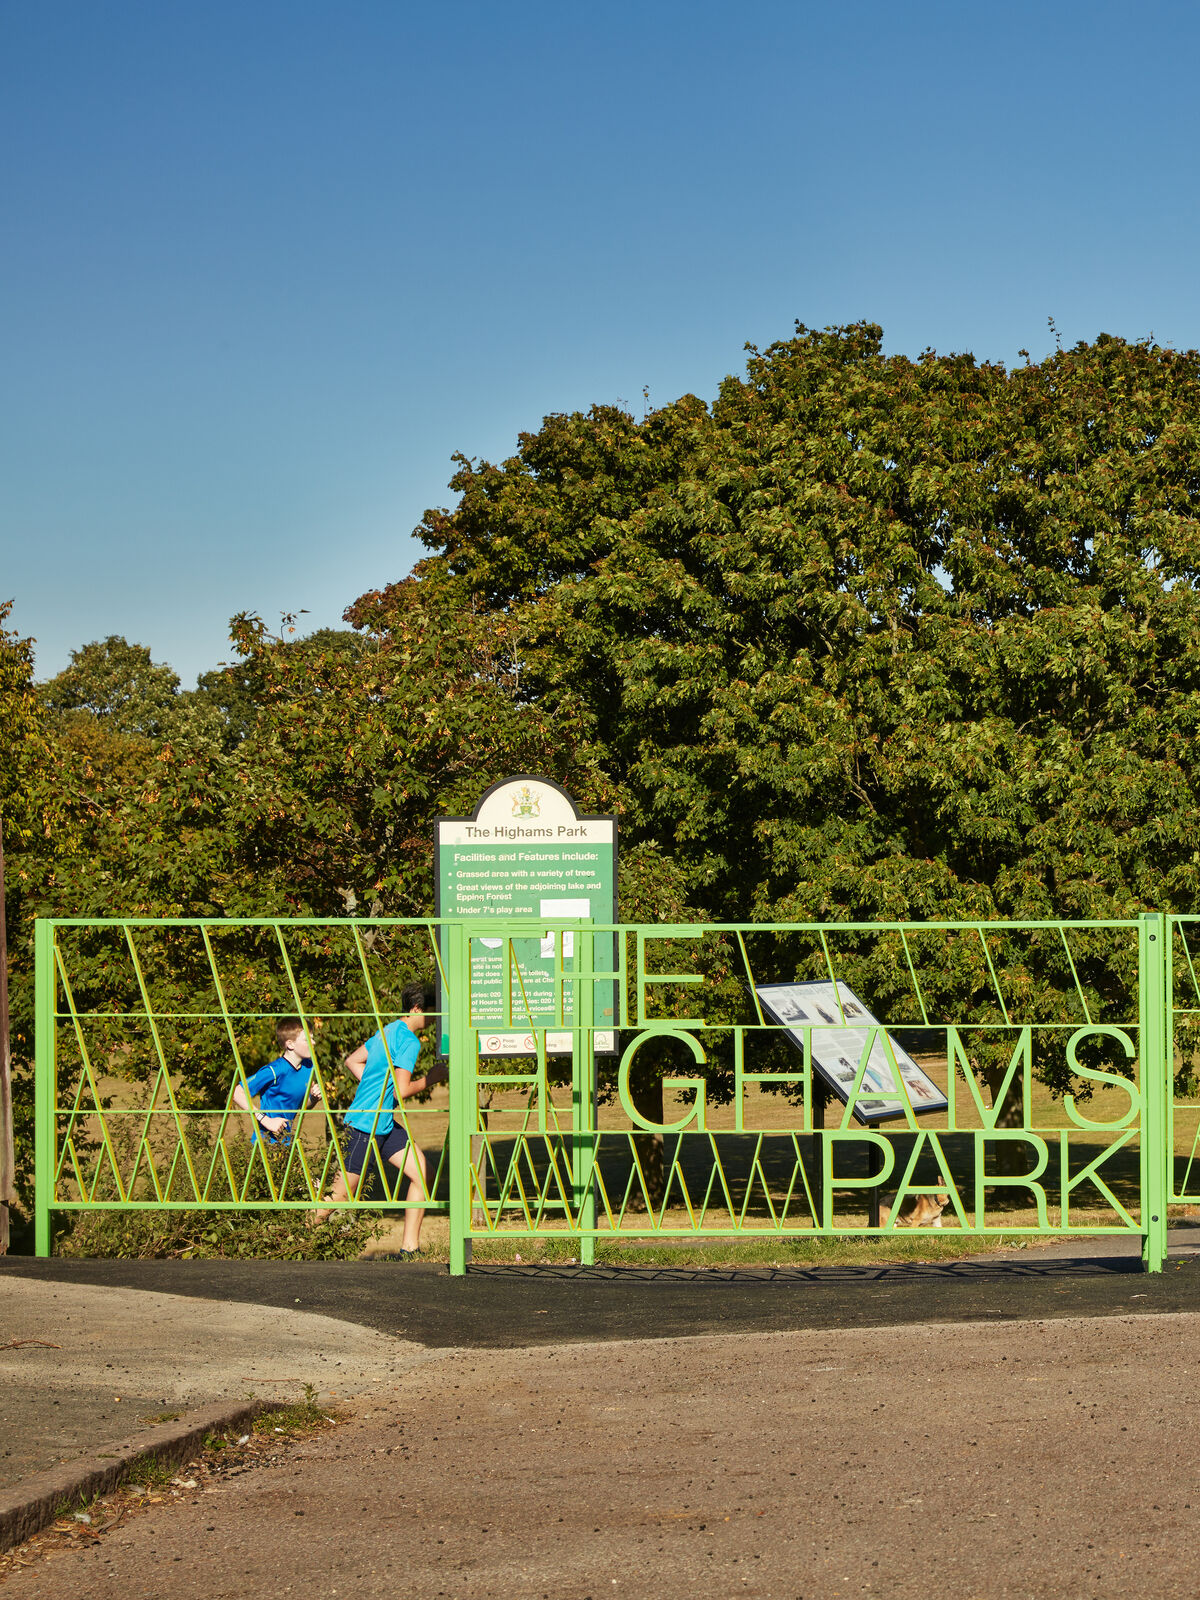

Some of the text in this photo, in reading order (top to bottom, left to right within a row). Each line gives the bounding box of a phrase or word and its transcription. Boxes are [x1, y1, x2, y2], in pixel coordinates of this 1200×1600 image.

[465, 825, 588, 840] The Highams Park
[454, 851, 599, 862] Facilities and Features include:
[456, 870, 490, 878] Grassed
[537, 869, 563, 878] variety
[565, 869, 574, 877] of
[575, 869, 596, 877] trees
[456, 883, 479, 891] Great
[480, 883, 503, 891] views
[529, 882, 567, 891] adjoining
[567, 882, 585, 890] lake
[586, 881, 602, 890] and
[456, 892, 513, 902] Epping Forest
[456, 906, 481, 914] Under
[482, 905, 495, 914] 7's
[496, 905, 513, 915] play
[466, 924, 705, 1028] THE
[466, 1026, 1142, 1133] HIGHAMS
[822, 1130, 1142, 1230] PARK
